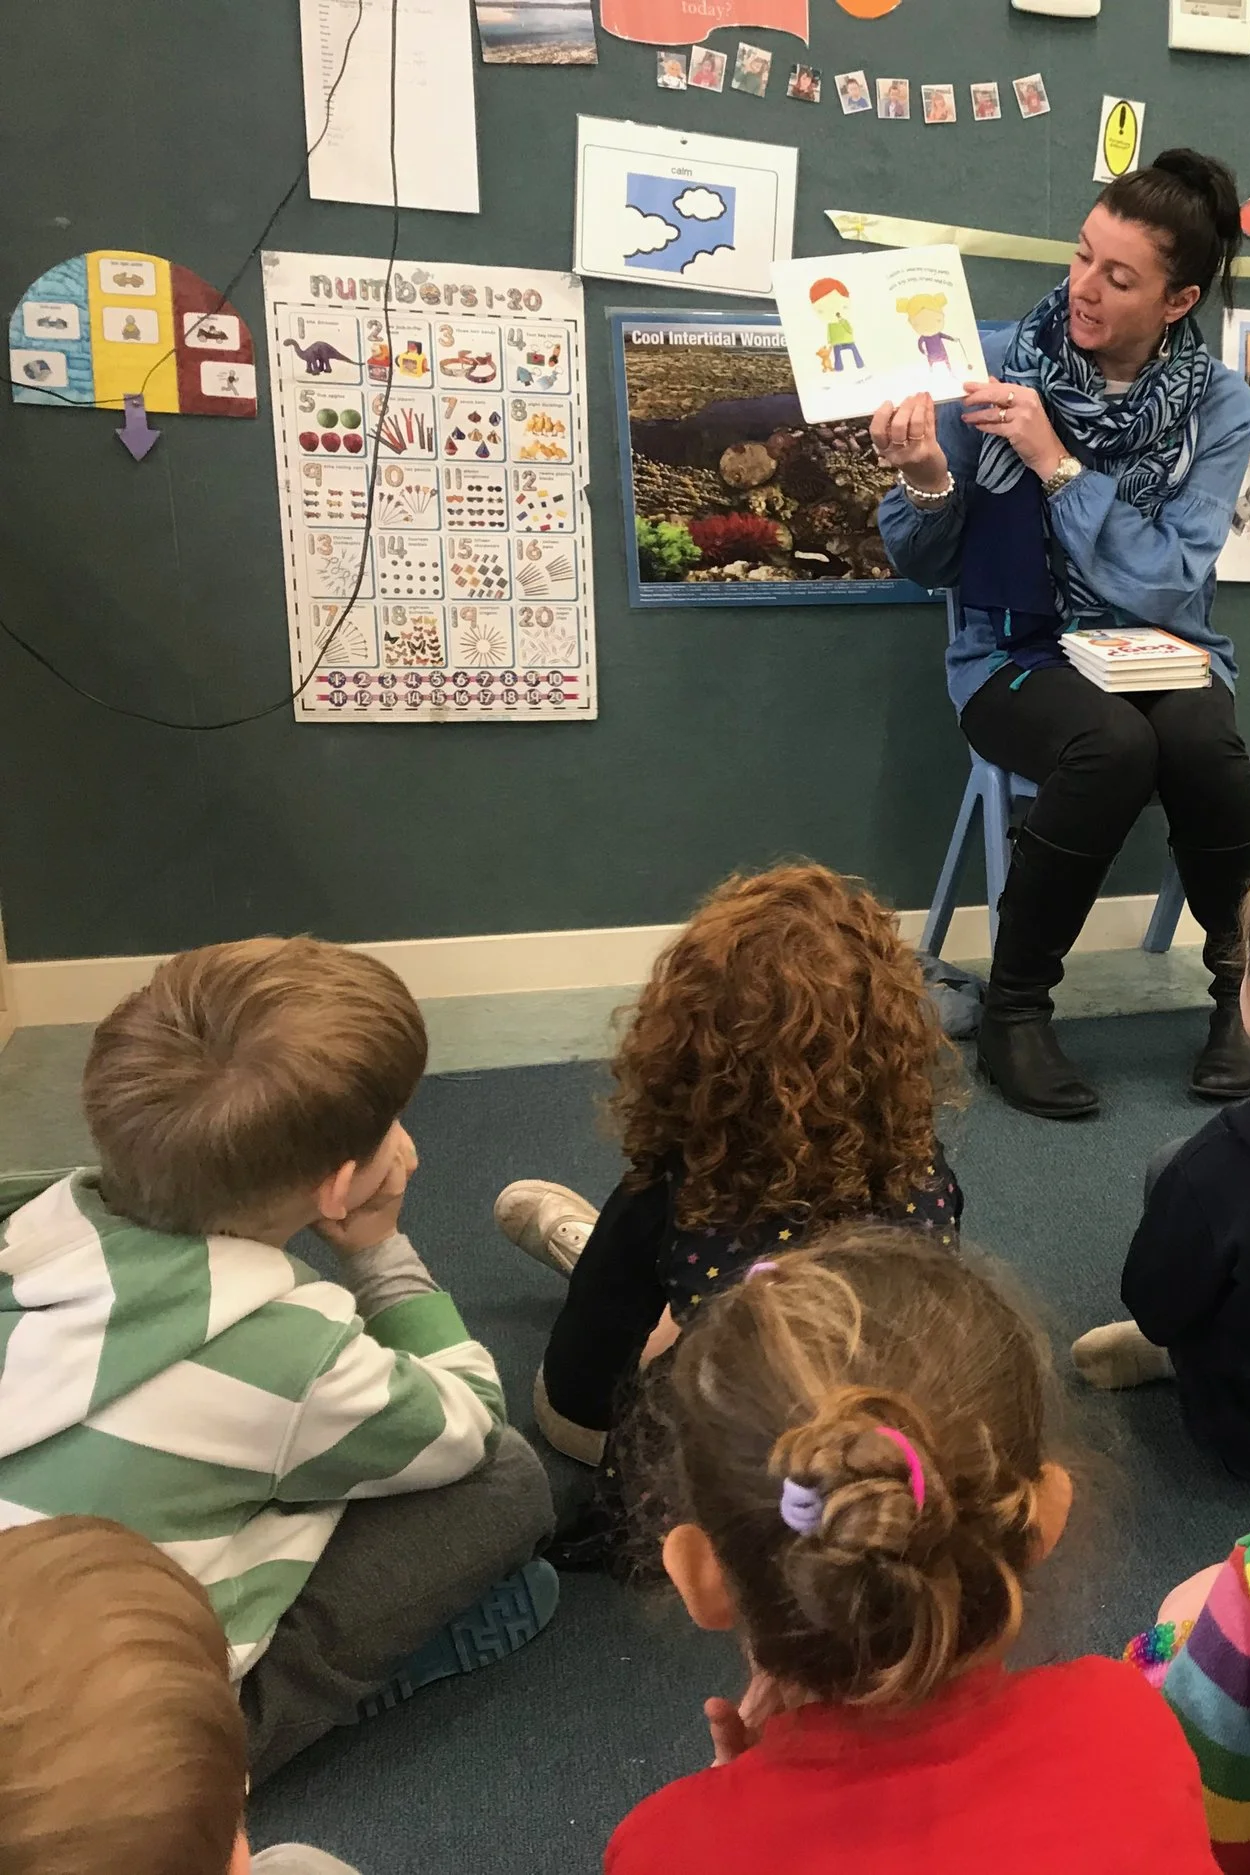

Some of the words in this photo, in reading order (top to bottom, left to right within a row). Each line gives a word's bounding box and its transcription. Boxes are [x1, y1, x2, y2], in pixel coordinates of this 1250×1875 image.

[681, 0, 733, 21] today?
[671, 167, 693, 176] calm
[309, 272, 479, 308] numbers
[484, 285, 543, 312] 1-20
[297, 316, 306, 340] 1
[366, 319, 384, 342] 2
[438, 324, 455, 348] 3
[507, 327, 527, 351] 4
[632, 329, 664, 345] Cool
[668, 331, 736, 346] Intertidal
[298, 389, 316, 413] 5
[371, 392, 390, 416] 6
[441, 396, 458, 420] 7
[510, 398, 528, 422] 8
[302, 462, 323, 487] 9
[376, 464, 405, 488] 10
[444, 467, 463, 490] 11
[512, 469, 538, 492] 12
[307, 533, 334, 556] 13
[379, 535, 408, 559] 14
[448, 537, 473, 560] 15
[516, 538, 543, 561] 16
[312, 604, 339, 627] 17
[382, 604, 408, 626] 18
[451, 606, 478, 629] 19
[518, 605, 554, 629] 20
[334, 673, 342, 686] 1
[357, 673, 367, 687] 2
[383, 673, 393, 688] 3
[407, 673, 416, 687] 4
[432, 673, 442, 686] 5
[456, 672, 466, 686] 6
[480, 673, 490, 686] 7
[504, 672, 514, 685] 8
[526, 672, 536, 685] 9
[549, 672, 562, 685] 10
[333, 692, 343, 704] 11
[356, 692, 370, 705] 12
[382, 692, 396, 705] 13
[407, 692, 420, 705] 14
[431, 691, 445, 704] 15
[455, 691, 469, 704] 16
[479, 691, 492, 704] 17
[503, 691, 516, 703] 18
[526, 691, 539, 703] 19
[549, 691, 564, 703] 20
